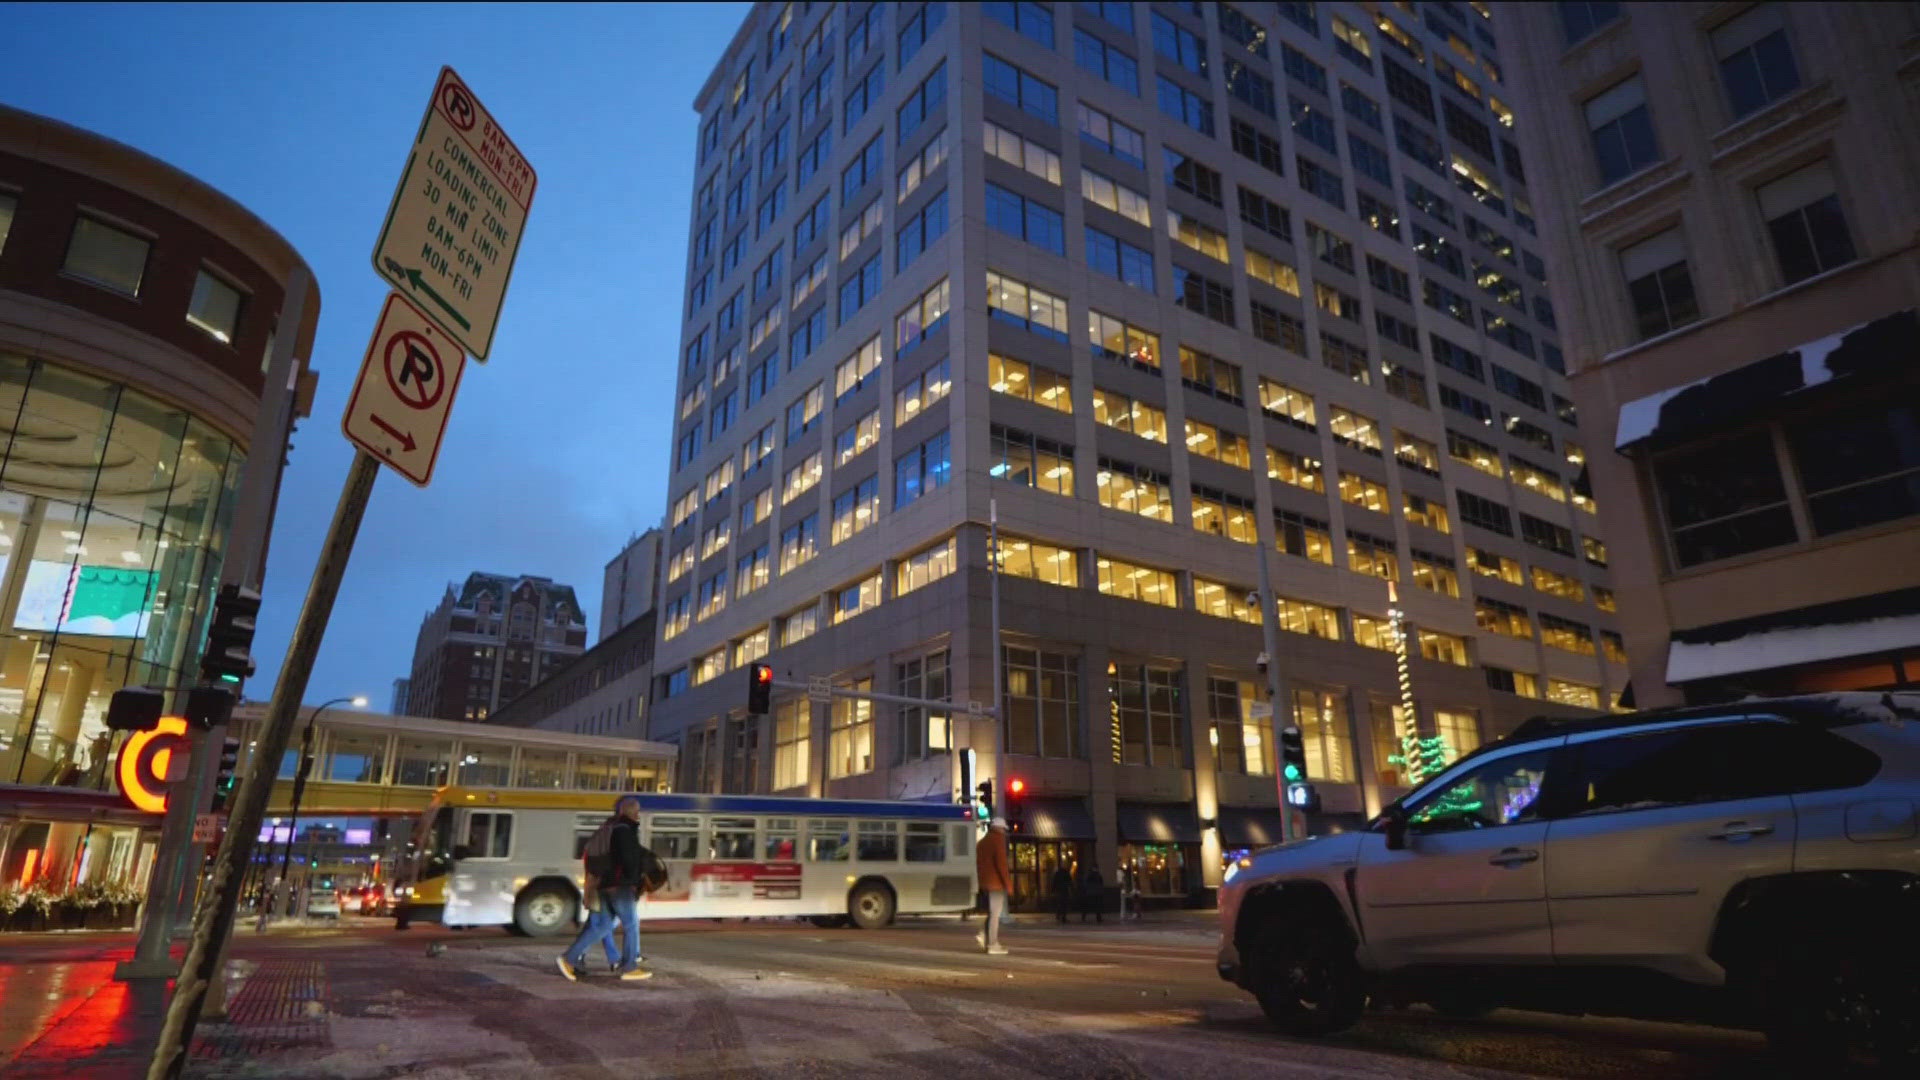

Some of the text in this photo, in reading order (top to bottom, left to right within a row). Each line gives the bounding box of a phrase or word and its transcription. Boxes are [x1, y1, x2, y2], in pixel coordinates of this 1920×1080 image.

[444, 137, 507, 218] COMMERCIAL
[480, 140, 523, 199] MON-FRI
[483, 121, 529, 183] 8AM-6PM
[423, 180, 499, 265] 30 MIN LIMIT
[427, 151, 509, 248] LOADING ZONE
[421, 242, 473, 301] MON-FRI
[427, 216, 483, 280] 8AM-6PM
